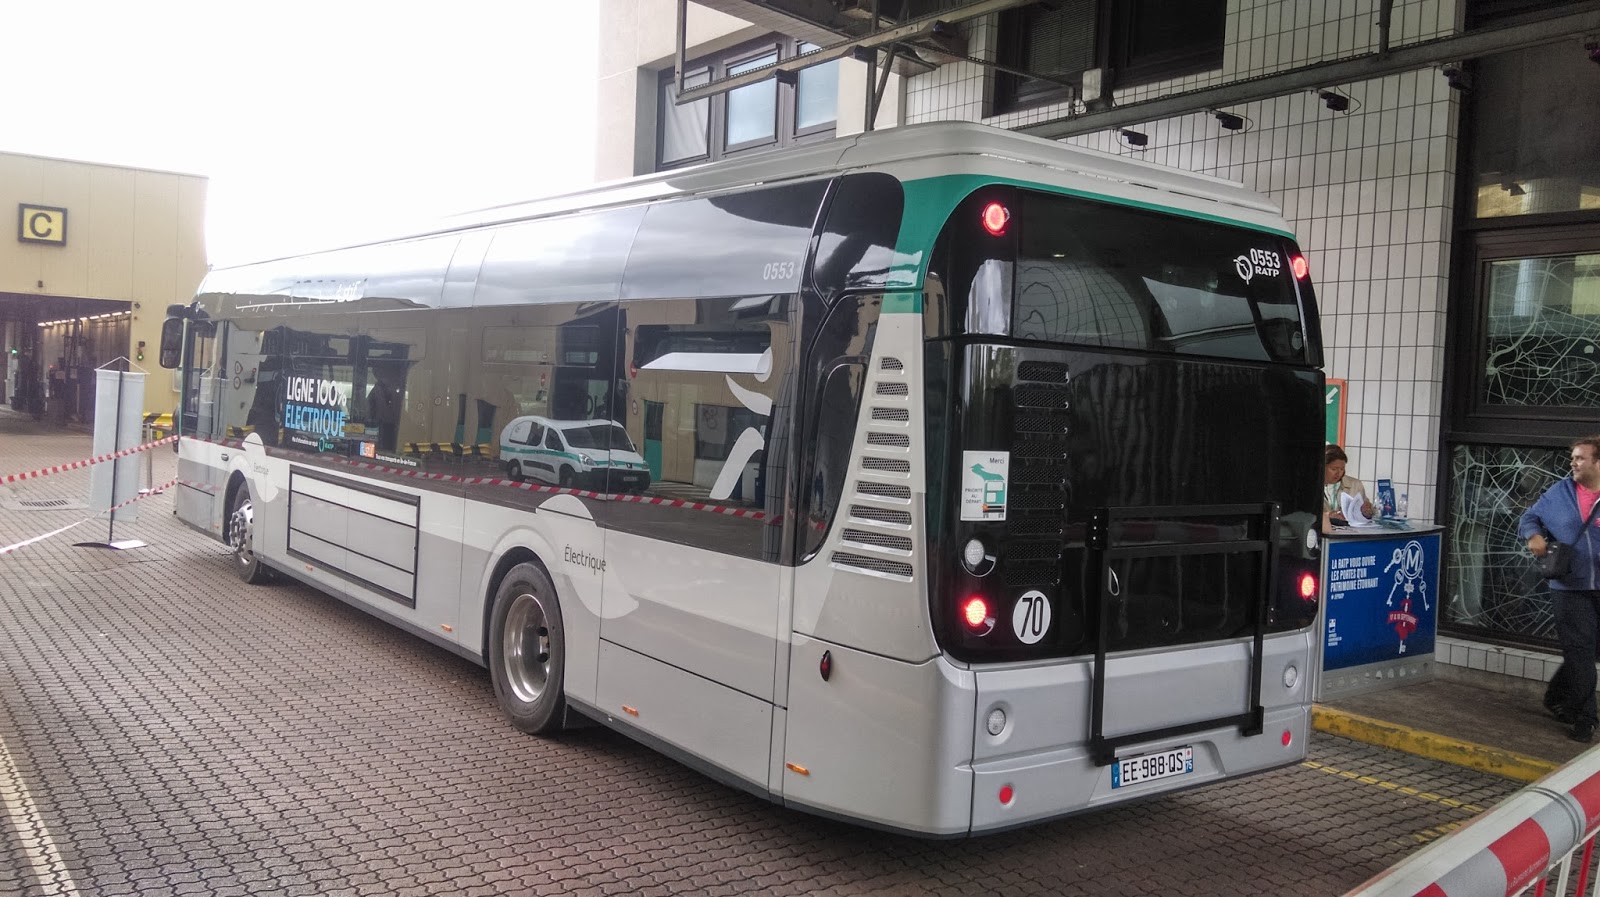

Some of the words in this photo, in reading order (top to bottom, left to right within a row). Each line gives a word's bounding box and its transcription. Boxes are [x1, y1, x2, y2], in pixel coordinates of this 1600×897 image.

[29, 212, 52, 238] C
[1250, 248, 1281, 269] 0553
[763, 261, 795, 281] 0553
[1255, 266, 1280, 278] RATP
[286, 376, 315, 403] LIGNE
[316, 379, 347, 407] 100%
[284, 401, 347, 440] ÉLECTRIQUE
[989, 457, 1005, 465] Merci
[564, 543, 607, 576] Électrique
[1331, 559, 1338, 570] LA
[1337, 557, 1350, 569] RATP
[1331, 570, 1340, 582] LES
[1020, 596, 1044, 638] 70
[1122, 752, 1183, 783] EE-988-QS
